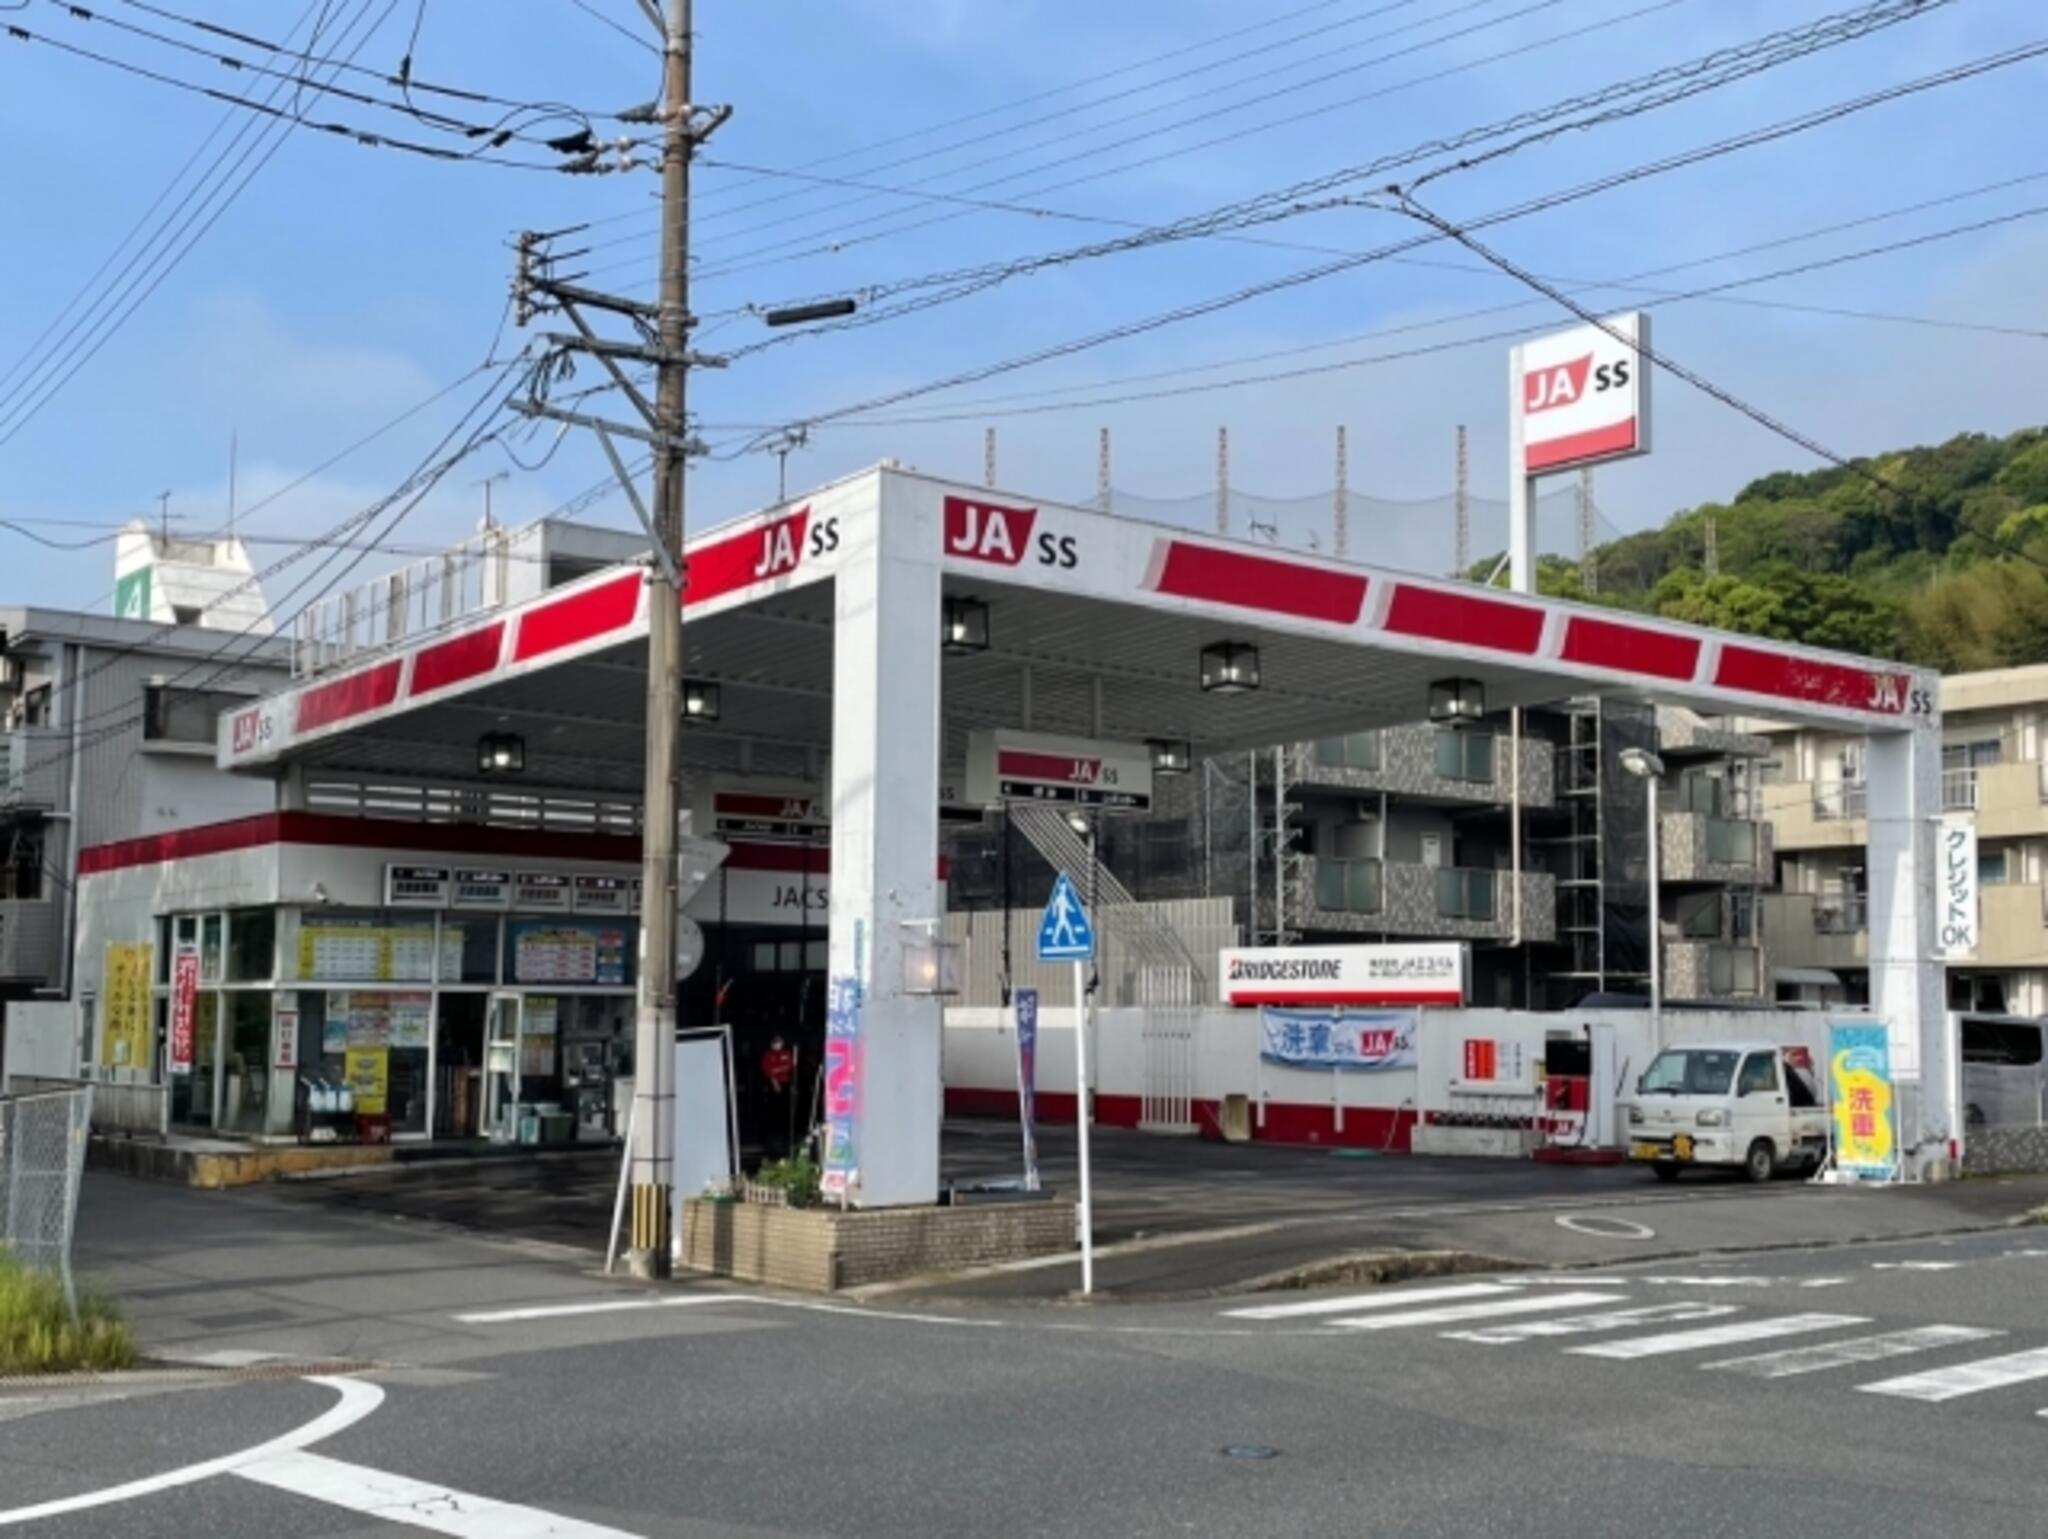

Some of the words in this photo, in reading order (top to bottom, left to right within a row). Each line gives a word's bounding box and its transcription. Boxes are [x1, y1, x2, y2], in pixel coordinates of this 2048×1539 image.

[1528, 368, 1577, 409] JA
[1595, 360, 1629, 392] SS
[754, 522, 796, 577] JA
[810, 516, 840, 558] SS
[952, 505, 1016, 560] JA
[1038, 532, 1078, 569] SS
[1868, 673, 1901, 711] JA
[1911, 690, 1932, 715] SS
[1067, 760, 1093, 782] JA
[1102, 767, 1120, 785] SS
[1229, 958, 1342, 980] BRIDGESTONE
[1365, 1033, 1387, 1053] JA
